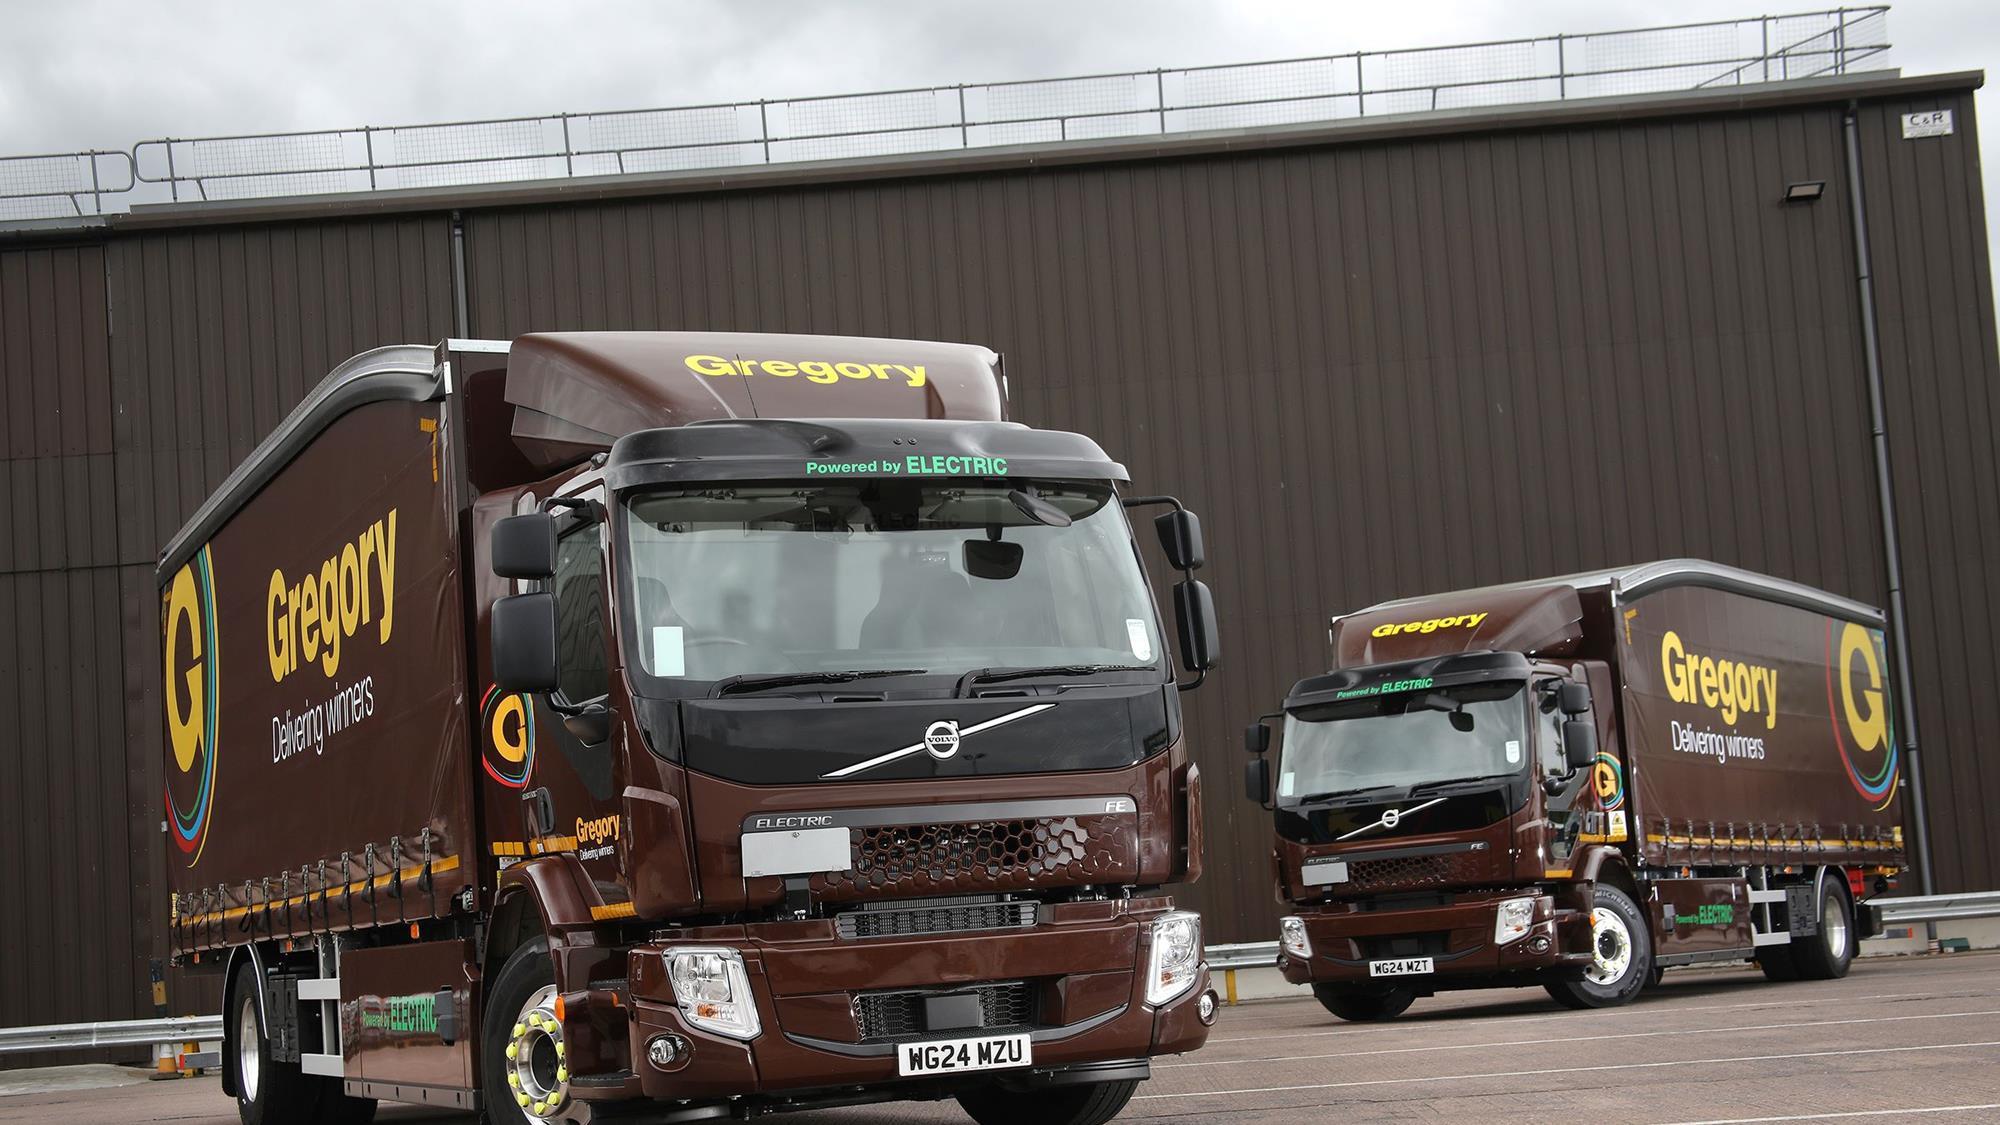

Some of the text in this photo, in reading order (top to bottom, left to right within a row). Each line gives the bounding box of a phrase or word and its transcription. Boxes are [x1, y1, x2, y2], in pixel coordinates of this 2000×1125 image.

[684, 354, 926, 387] Gregory
[806, 455, 1008, 476] Powered by ELECTRIC
[267, 507, 397, 683] Gregory
[1372, 612, 1488, 637] Gregory
[165, 562, 206, 773] G
[1661, 630, 1777, 730] Gregory
[1336, 677, 1433, 699] Powered by ELECTRIC
[1839, 621, 1888, 751] G
[272, 675, 374, 764] Delivering winners
[492, 694, 528, 763] G
[1671, 720, 1765, 764] Delivering winners
[756, 815, 833, 829] ELECTRIC
[1104, 800, 1128, 813] FE
[576, 814, 620, 845] Gregory
[1470, 842, 1484, 850] FE
[1374, 960, 1428, 975] WG24 MZT
[391, 995, 437, 1032] ELECTRIC
[908, 1039, 1022, 1071] WG24 MZU
